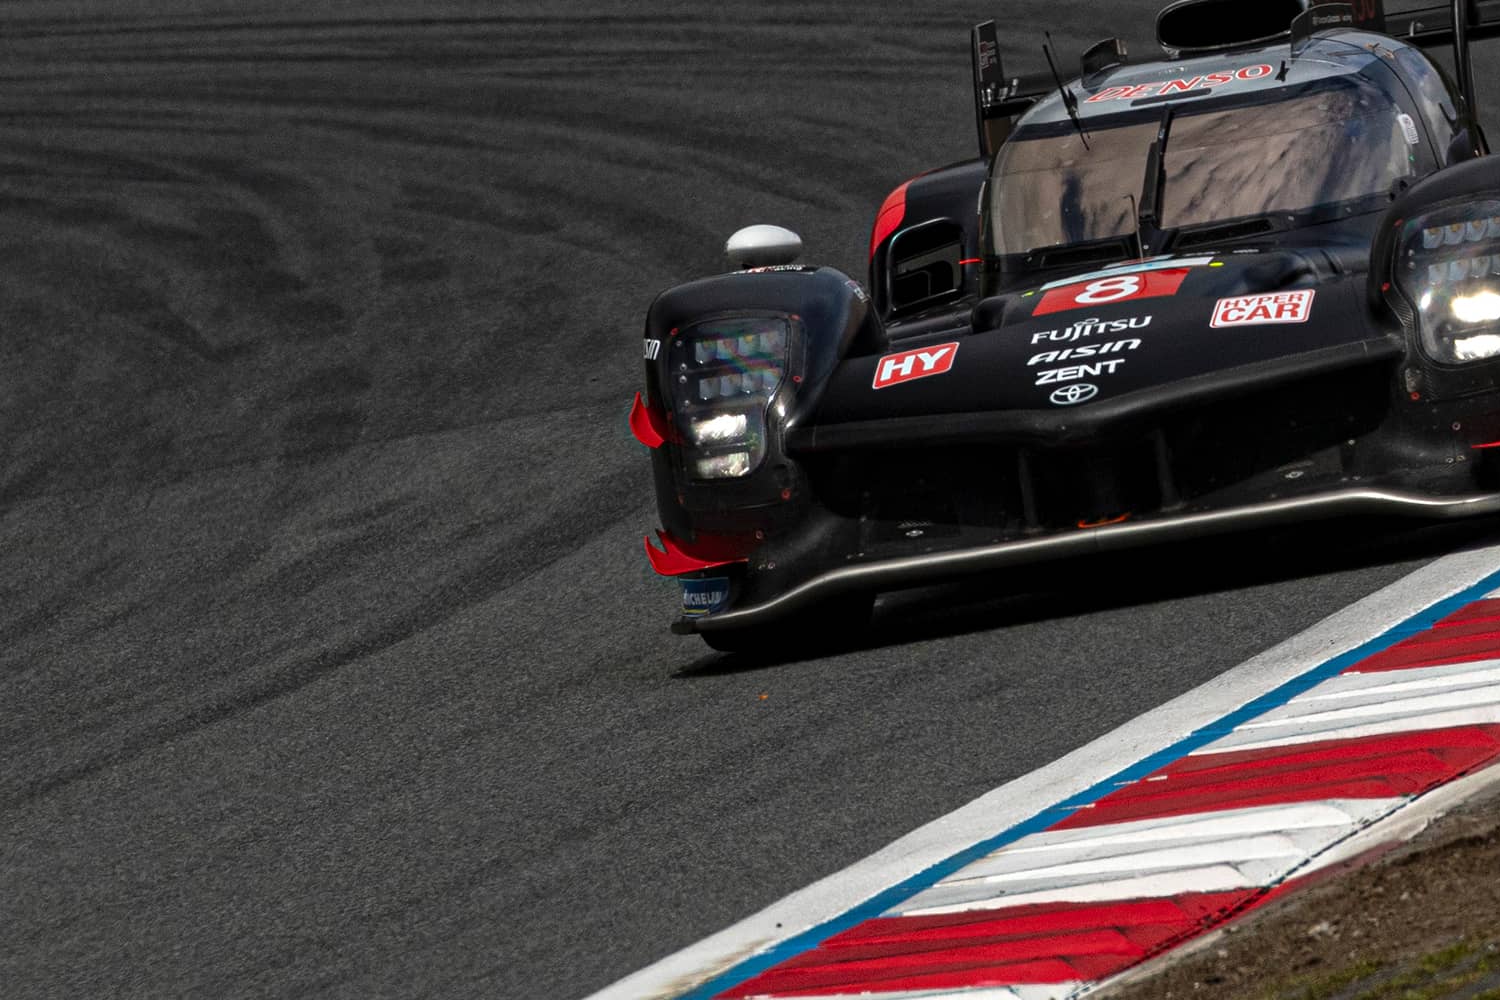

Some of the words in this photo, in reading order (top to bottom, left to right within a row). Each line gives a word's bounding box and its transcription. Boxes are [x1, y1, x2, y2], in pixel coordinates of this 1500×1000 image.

[1084, 63, 1273, 103] DENSO
[1075, 275, 1140, 304] 8
[1224, 293, 1304, 309] HYPER
[1221, 303, 1301, 322] CAR
[1031, 315, 1152, 345] FUJITSU
[880, 347, 951, 382] HY
[1027, 338, 1142, 366] AISIN
[1035, 359, 1125, 386] ZENT
